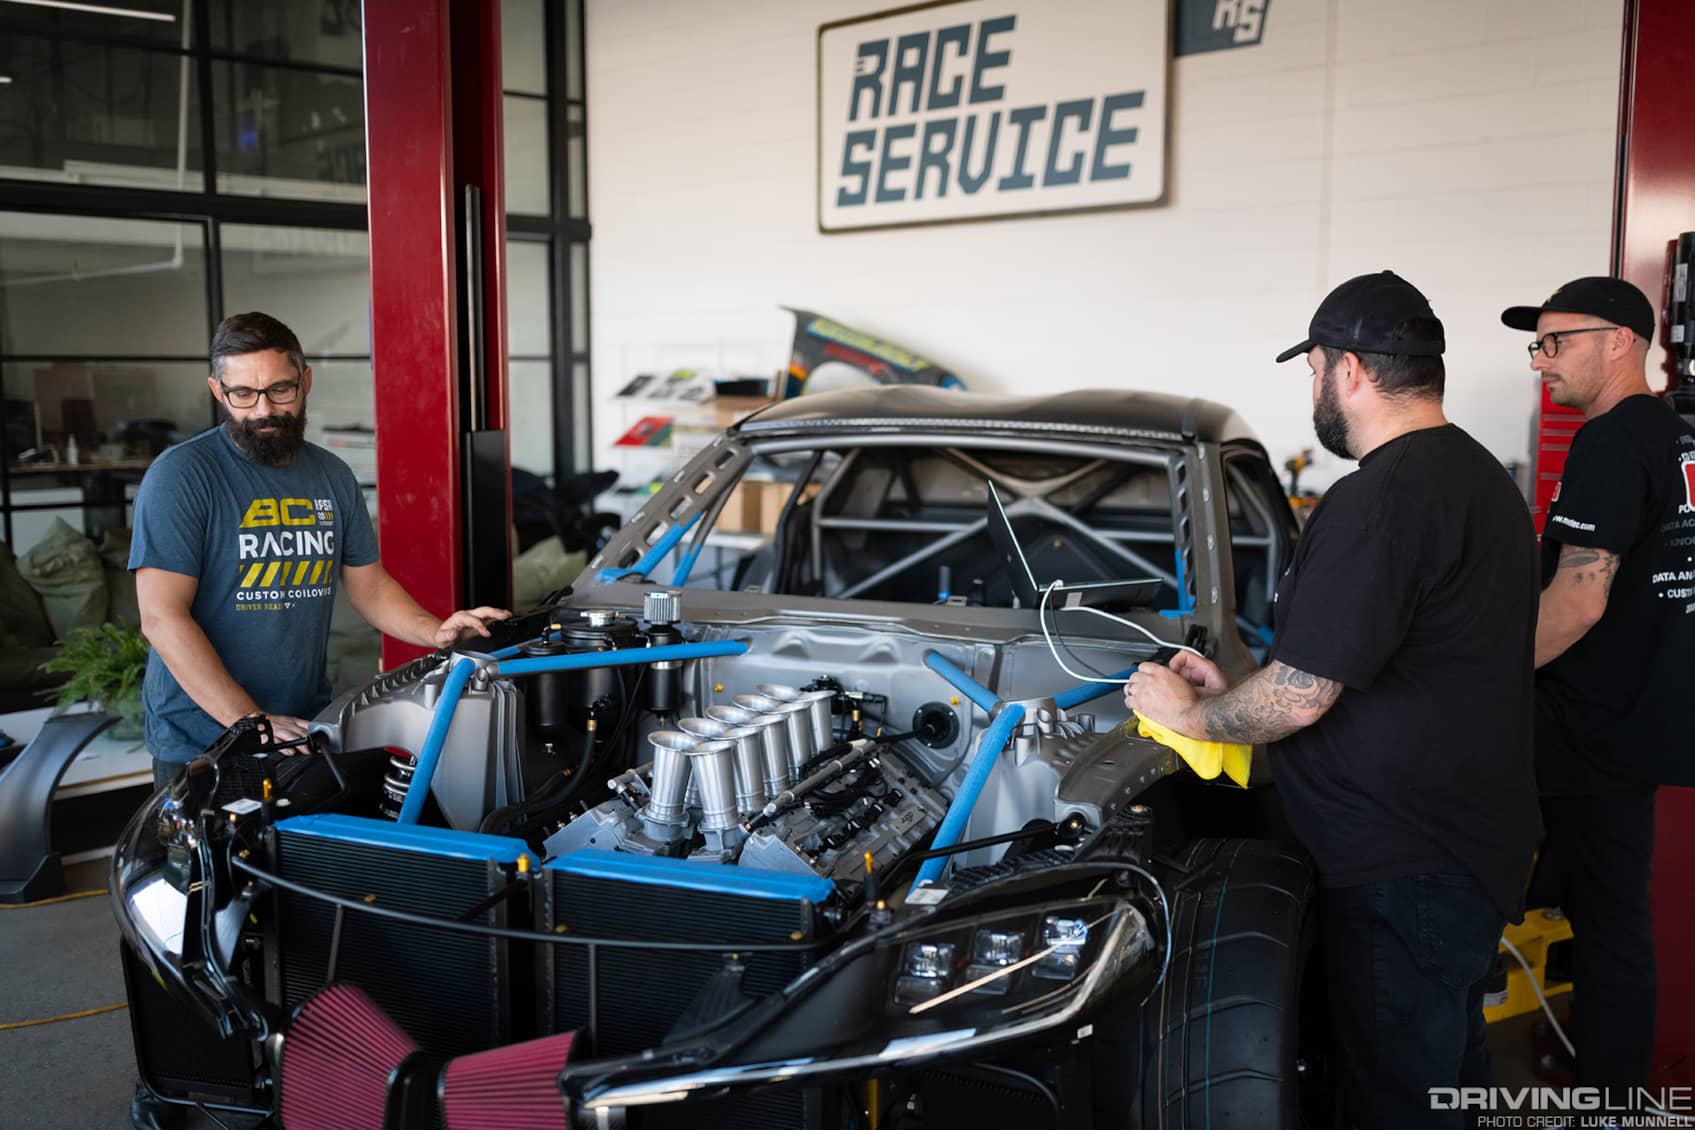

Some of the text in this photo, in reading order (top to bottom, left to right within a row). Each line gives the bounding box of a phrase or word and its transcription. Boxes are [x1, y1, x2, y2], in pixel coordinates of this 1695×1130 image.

[849, 15, 1017, 121] RACE
[837, 91, 1146, 207] SERVICE
[239, 498, 316, 528] BC
[239, 530, 334, 560] RACING
